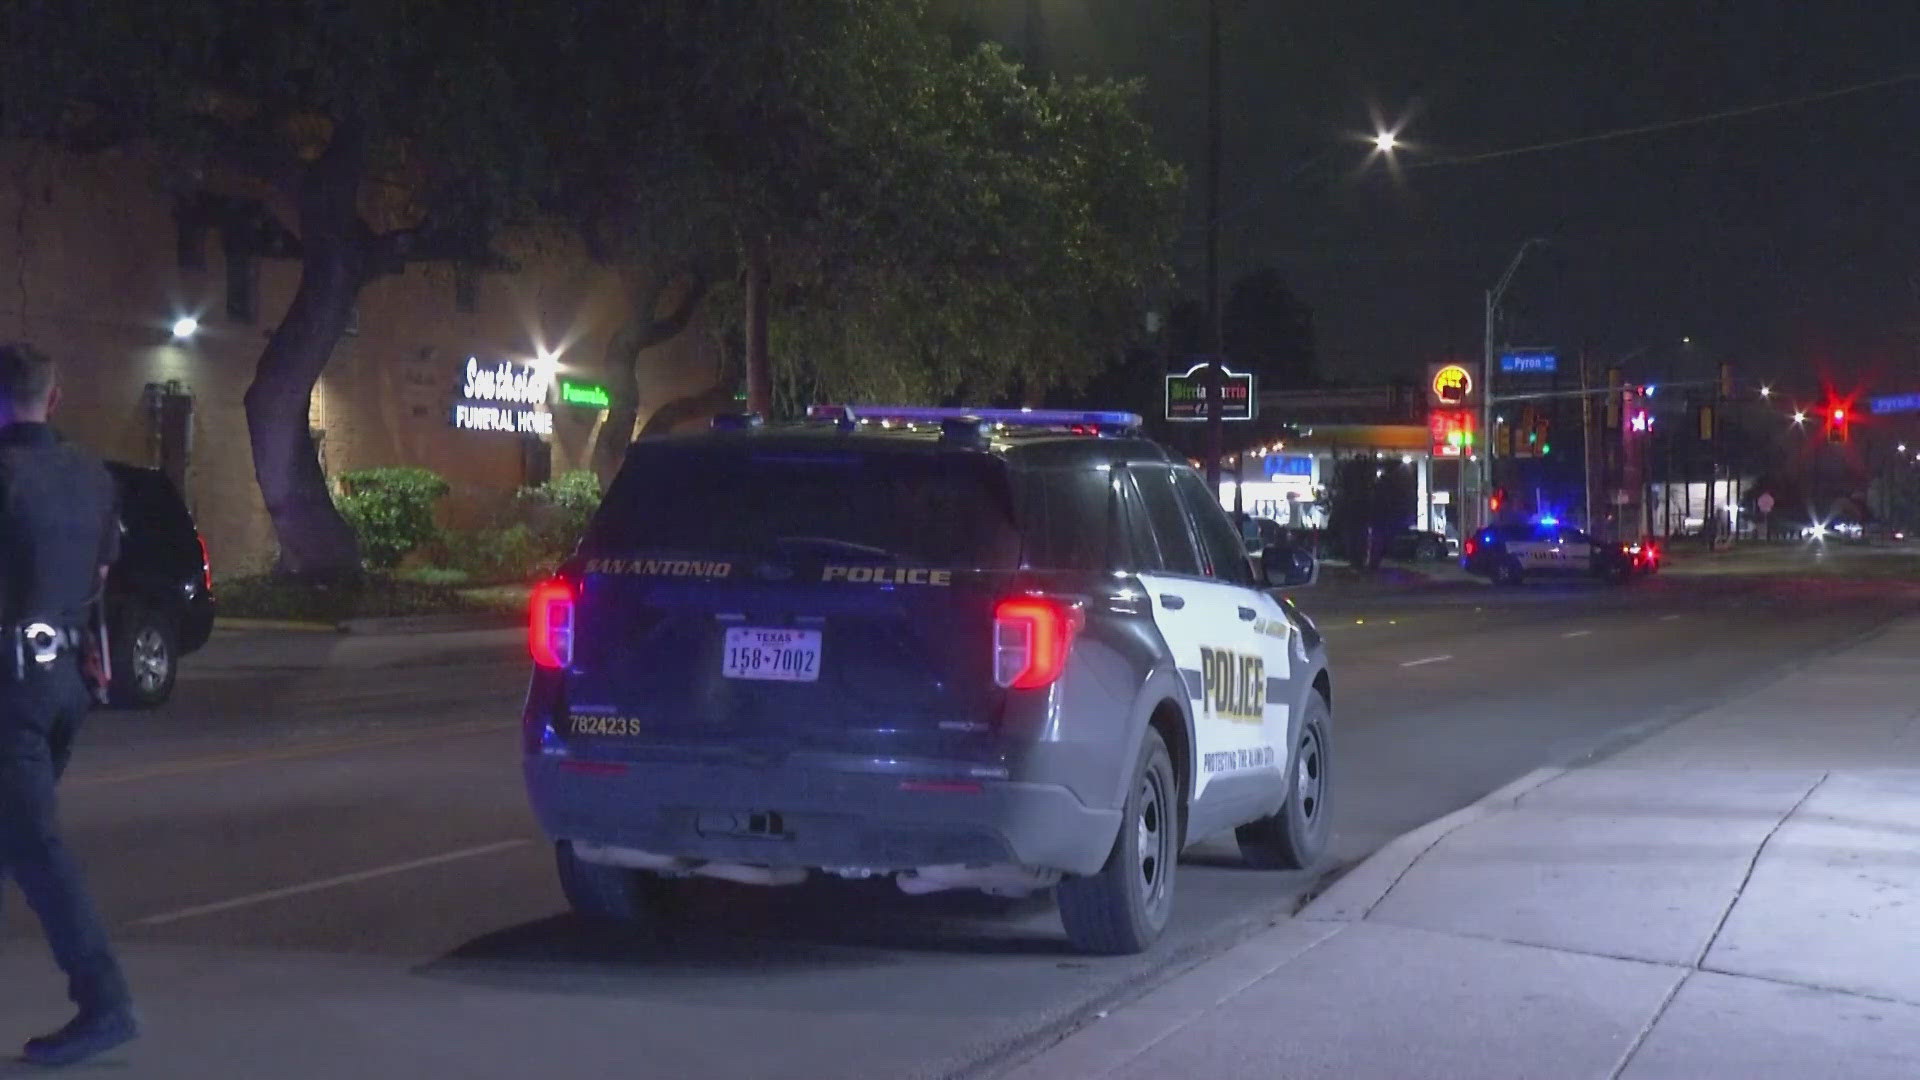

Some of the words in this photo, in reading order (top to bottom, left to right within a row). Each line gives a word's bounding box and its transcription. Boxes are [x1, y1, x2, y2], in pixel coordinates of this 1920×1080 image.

[1514, 356, 1541, 372] Pyron
[456, 404, 516, 432] FUNERAL
[517, 410, 553, 434] HOME
[584, 558, 624, 575] SAN
[626, 559, 732, 578] ANTONIO
[821, 565, 952, 586] POLICE
[755, 632, 792, 643] TEXAS
[1200, 645, 1265, 720] POLICE
